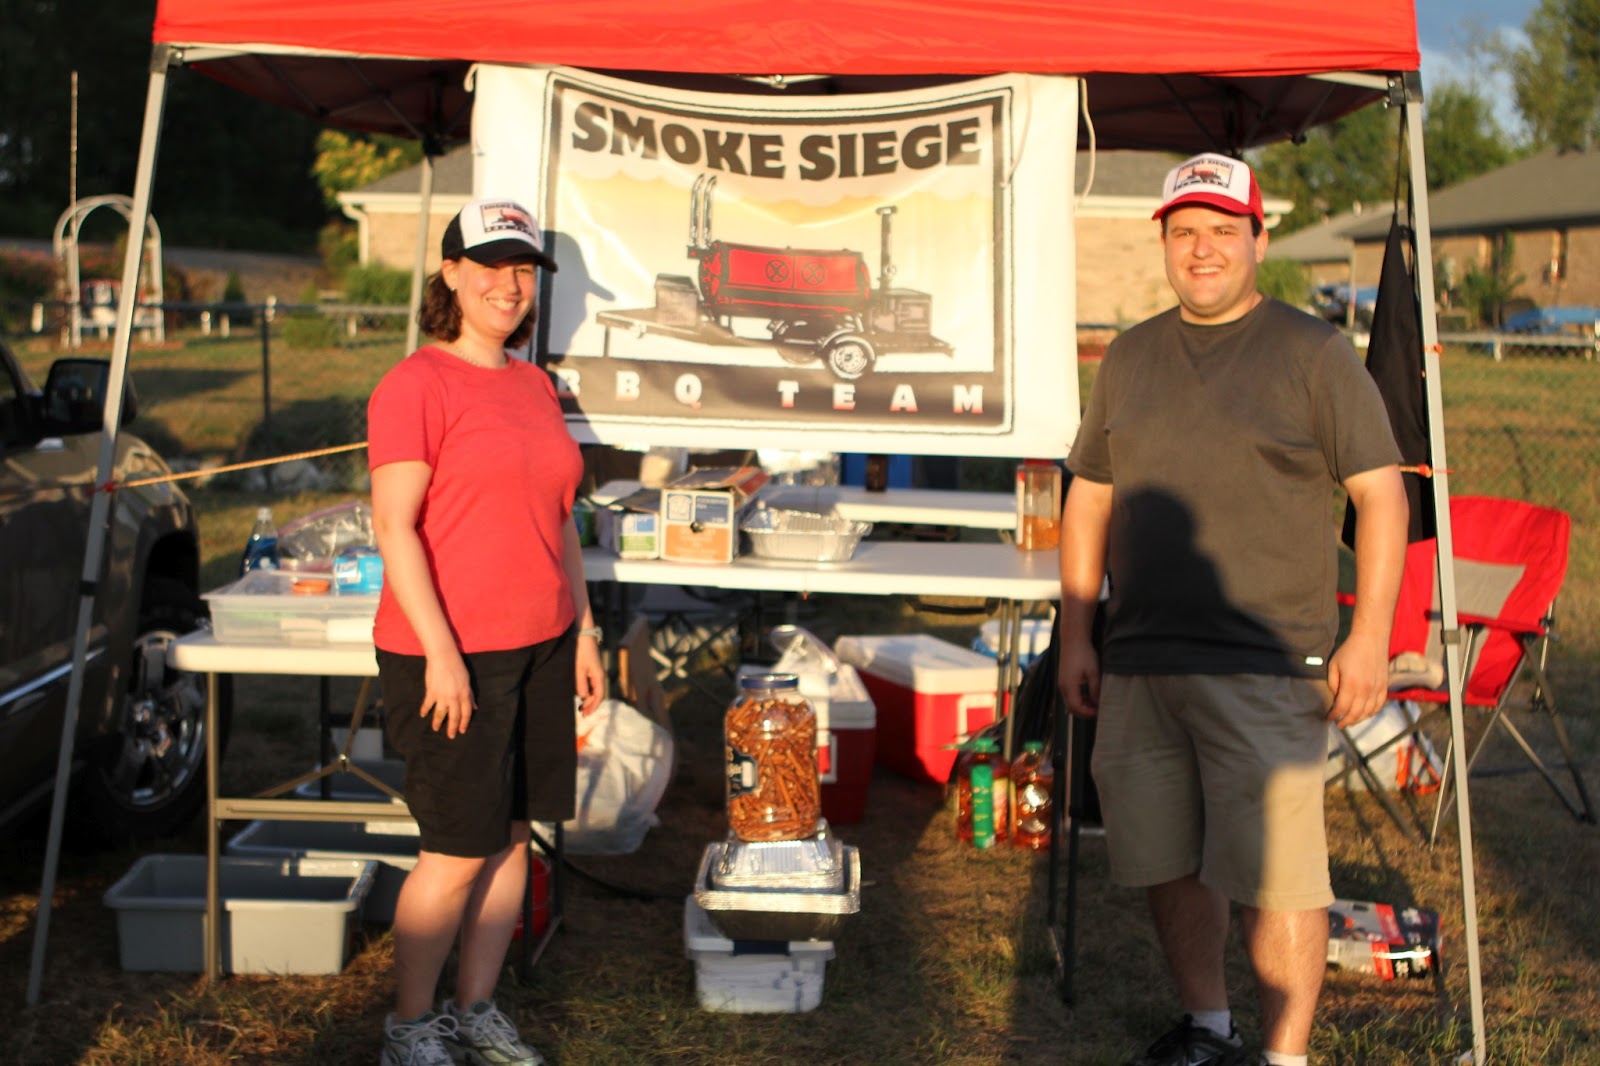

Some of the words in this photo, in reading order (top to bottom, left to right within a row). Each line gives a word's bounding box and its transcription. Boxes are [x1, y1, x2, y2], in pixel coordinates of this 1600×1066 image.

[572, 101, 786, 178] SMOKE
[799, 117, 981, 181] SIEGE
[557, 368, 703, 410] BBQ
[778, 380, 984, 414] TEAM
